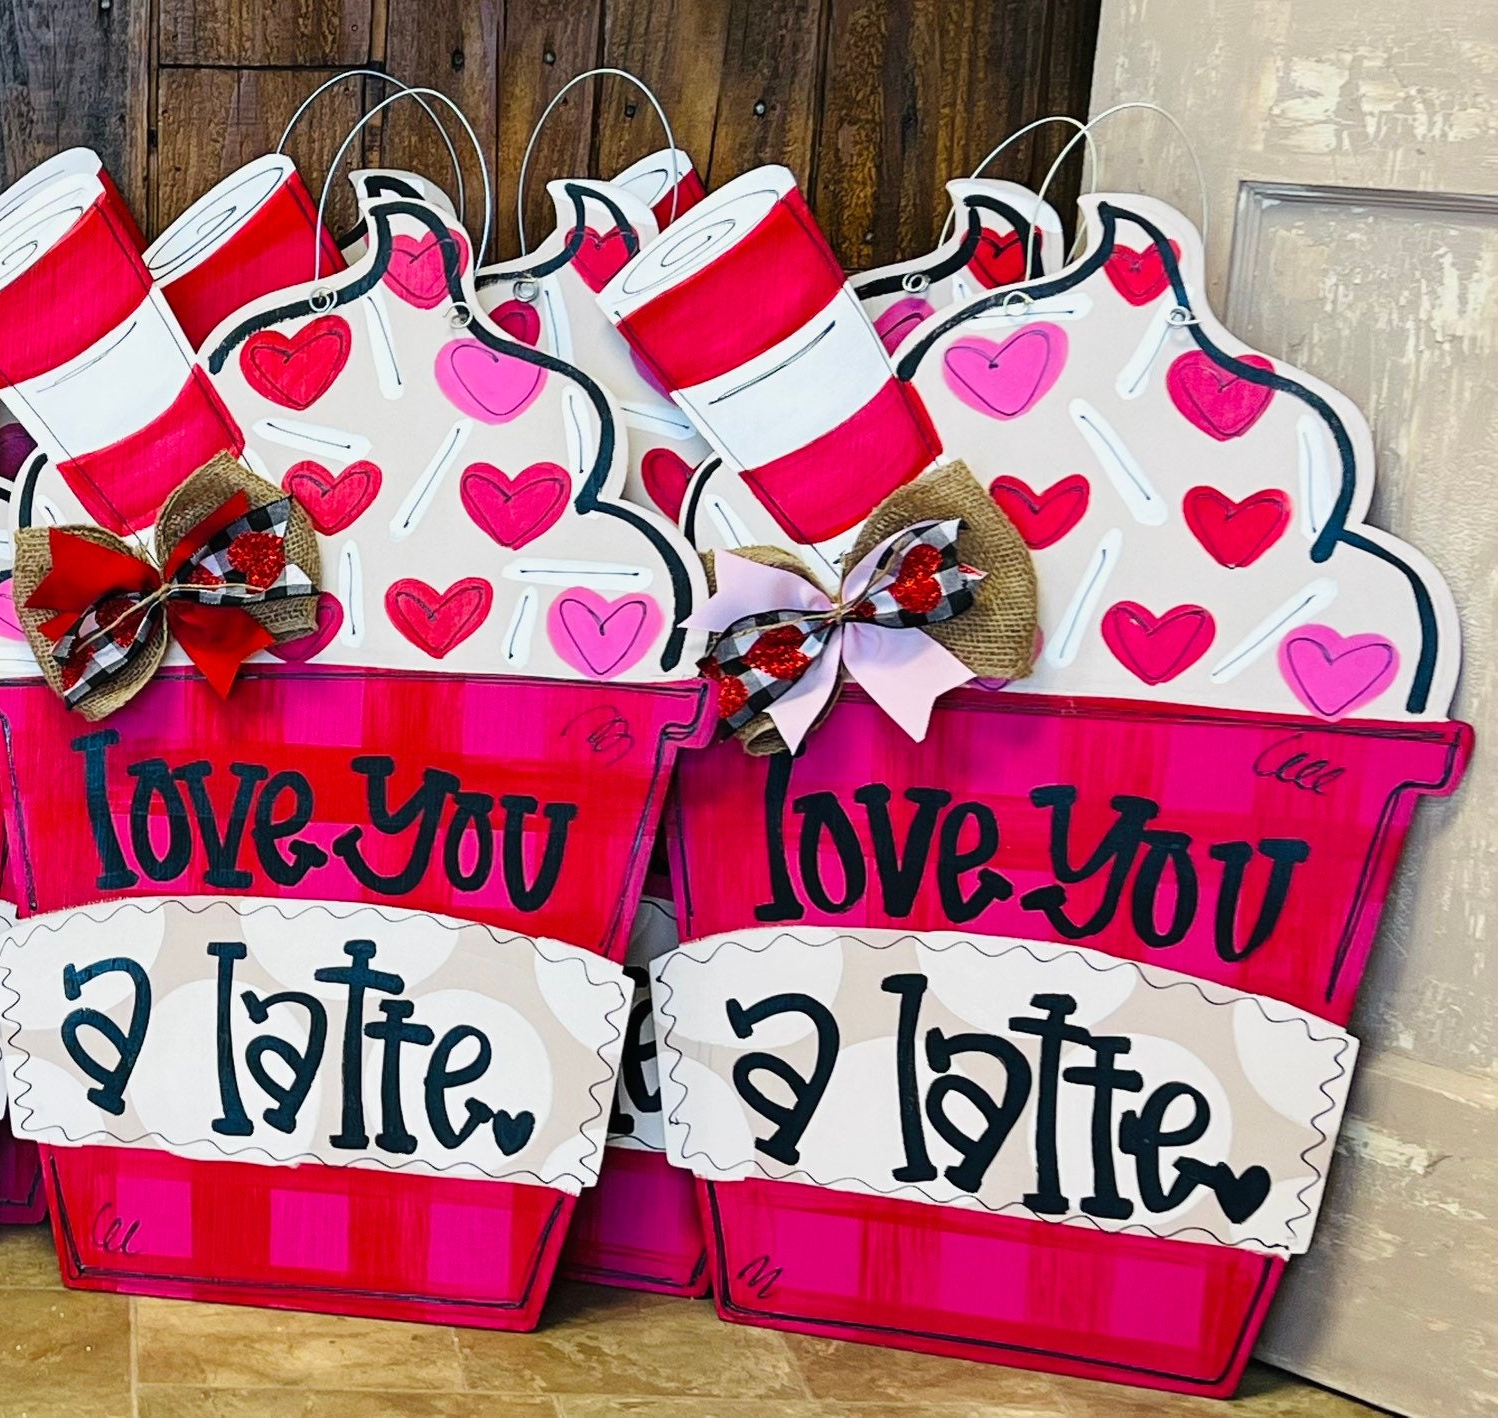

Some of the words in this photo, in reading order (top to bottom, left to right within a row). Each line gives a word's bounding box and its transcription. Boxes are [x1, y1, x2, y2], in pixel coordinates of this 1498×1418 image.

[71, 728, 328, 890] love
[332, 755, 578, 911] you
[754, 740, 1013, 923] love
[1020, 783, 1311, 963] you
[61, 956, 152, 1115] a
[207, 939, 494, 1155] latte
[725, 993, 841, 1165] a
[880, 973, 1219, 1220] latte
